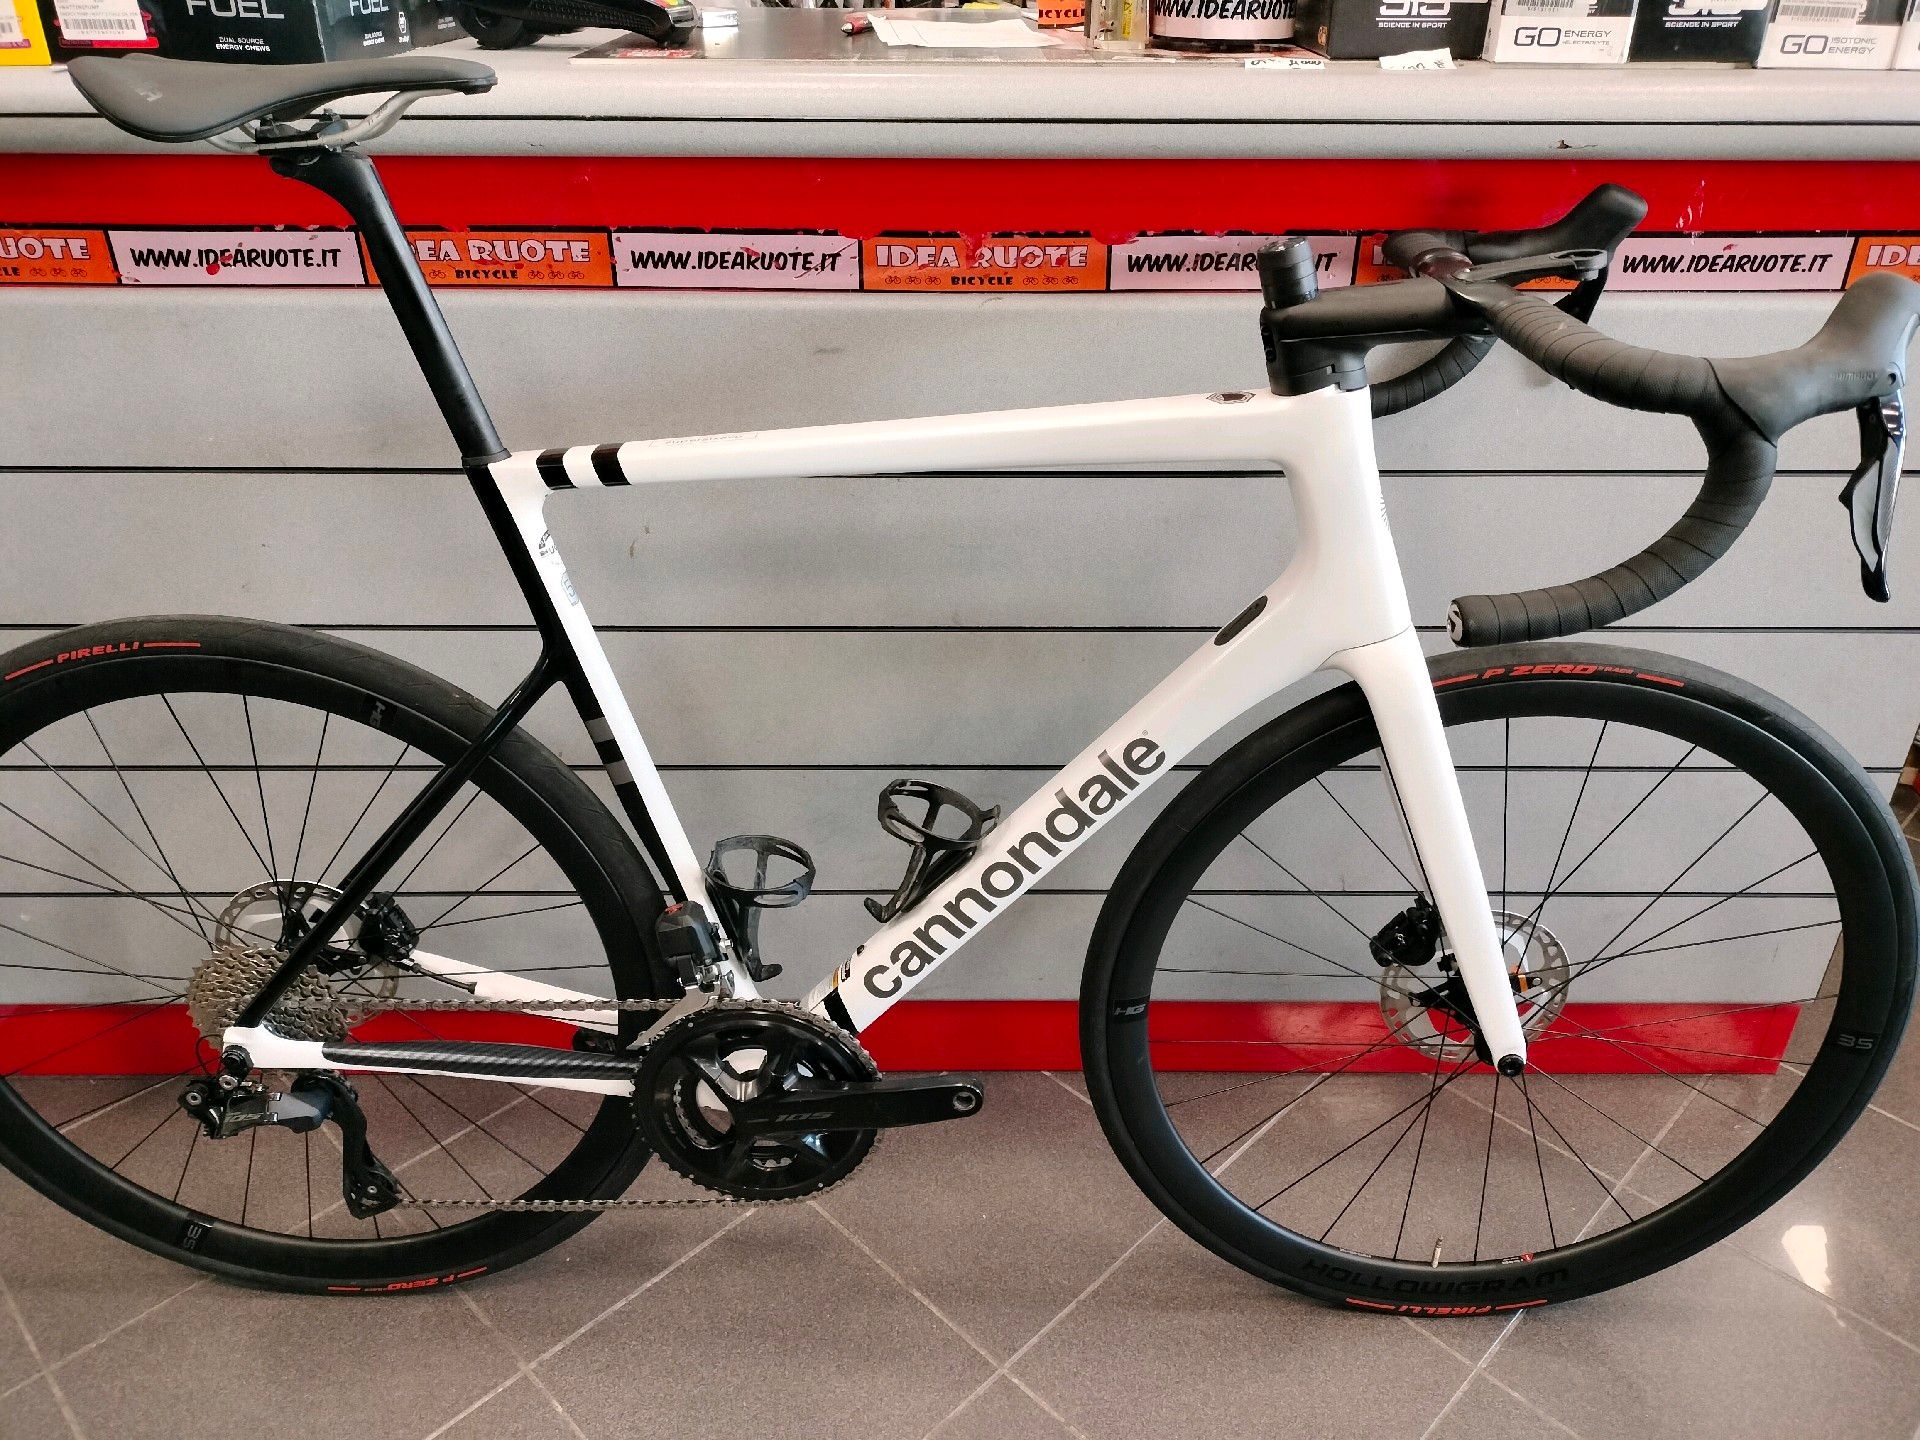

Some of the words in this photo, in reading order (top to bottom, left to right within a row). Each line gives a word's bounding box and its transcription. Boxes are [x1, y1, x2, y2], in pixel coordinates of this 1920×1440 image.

[1038, 8, 1086, 19] ICYCL
[1514, 26, 1561, 47] GO
[1564, 30, 1612, 38] ENERGY
[1780, 34, 1829, 55] GO
[1831, 37, 1877, 45] ISOTONIC
[1828, 46, 1876, 55] ENERGY
[0, 236, 91, 260] UOTE
[129, 247, 342, 268] WWW.IDEARUOTE.IT
[410, 239, 463, 262] EA
[466, 239, 591, 263] RUOTE
[875, 244, 961, 268] IDEA
[973, 244, 1089, 269] RUOTE
[630, 249, 843, 272] WWW.IDEARUOTE.IT
[1621, 253, 1834, 273] WWW.IDEARUOTE.IT
[455, 269, 519, 280] BICYCLE
[950, 275, 1014, 286] BICYCLE
[57, 641, 140, 664] PIRELLI
[1482, 667, 1506, 679] P
[1509, 663, 1599, 677] ZERO
[863, 737, 1166, 999] cannondale
[1300, 1258, 1569, 1295] HOLLOWGRAM
[1397, 1304, 1492, 1315] PIRELLI
